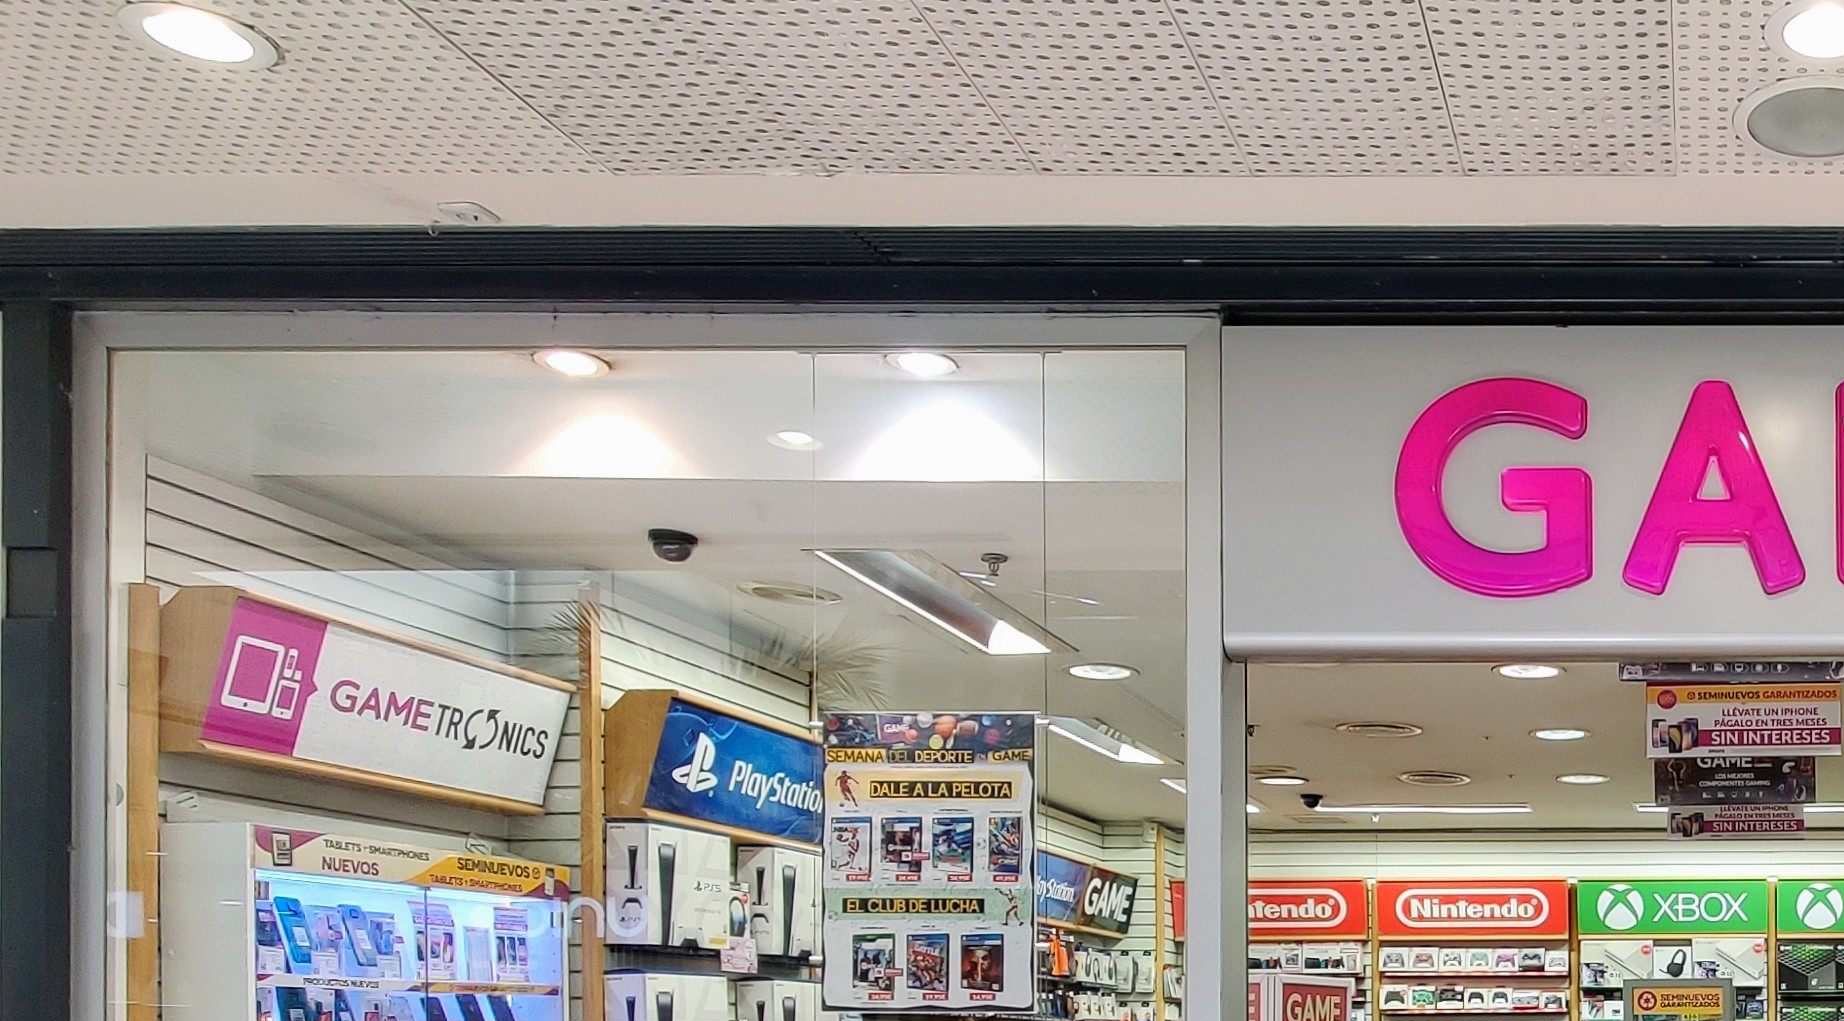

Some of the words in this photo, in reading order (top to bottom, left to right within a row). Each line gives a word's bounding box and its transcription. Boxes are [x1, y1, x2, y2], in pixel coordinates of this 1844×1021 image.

[1698, 691, 1760, 700] SEMINUEVOS
[1762, 690, 1838, 699] GARANTIZADOS
[1722, 706, 1761, 717] LLÉVATE
[1764, 708, 1779, 717] UN
[1781, 706, 1819, 716] IPHONE
[1714, 718, 1753, 728] PÁGALO
[1755, 719, 1767, 727] EN
[1769, 719, 1793, 727] TRES
[1796, 718, 1828, 727] MESES
[1711, 731, 1739, 745] SIN
[1744, 729, 1830, 745] INTERESES
[827, 750, 884, 763] SEMANA
[889, 750, 912, 763] DEL
[915, 750, 973, 763] DEPORTE
[992, 751, 1030, 761] GAME
[728, 759, 824, 814] PlayStatio
[871, 783, 909, 797] DALE
[913, 783, 925, 797] A
[928, 783, 949, 797] LA
[952, 783, 1012, 797] PELOTA
[1713, 822, 1733, 831] SIN
[1735, 821, 1797, 831] INTERESES
[322, 857, 380, 876] NUEVOS
[457, 857, 531, 879] SEMINUEVOS
[846, 900, 864, 913] EL
[867, 900, 906, 913] CLUB
[909, 900, 924, 913] DE
[931, 900, 980, 913] LUCHA
[1084, 877, 1133, 922] GAME
[1652, 892, 1749, 922] XBOX
[1248, 898, 1334, 919] ntendo
[1409, 898, 1536, 919] Nintendo
[1660, 993, 1720, 1001] SEMINUEVOS
